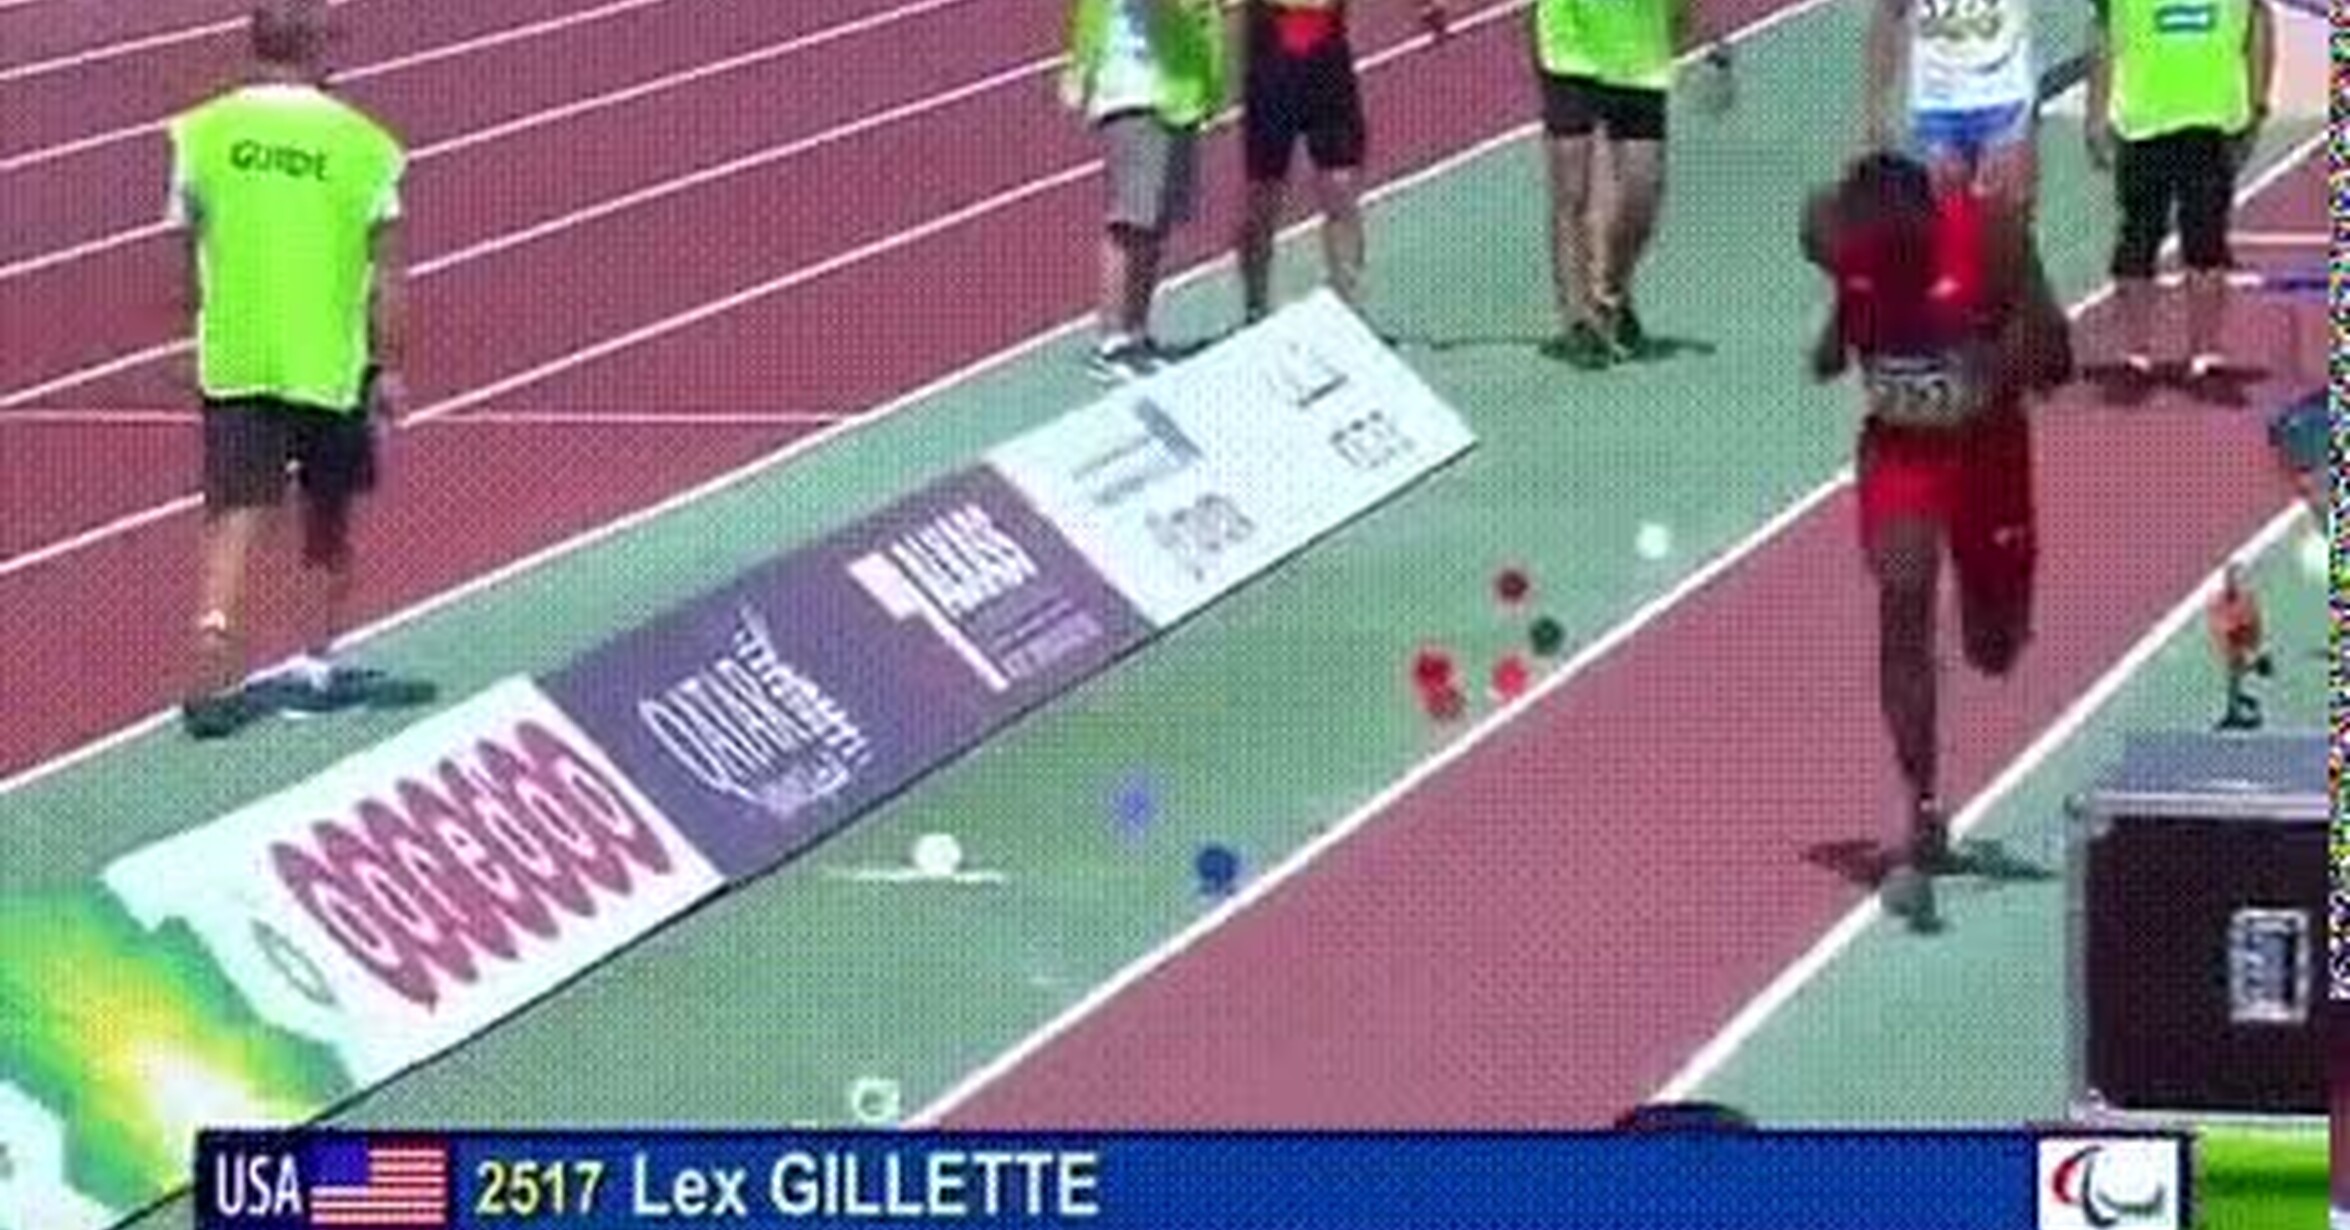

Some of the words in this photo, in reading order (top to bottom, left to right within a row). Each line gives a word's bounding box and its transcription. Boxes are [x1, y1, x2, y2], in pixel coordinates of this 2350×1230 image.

[230, 139, 326, 182] GUIDE
[637, 656, 816, 793] QATAR
[282, 735, 656, 990] ooredoo
